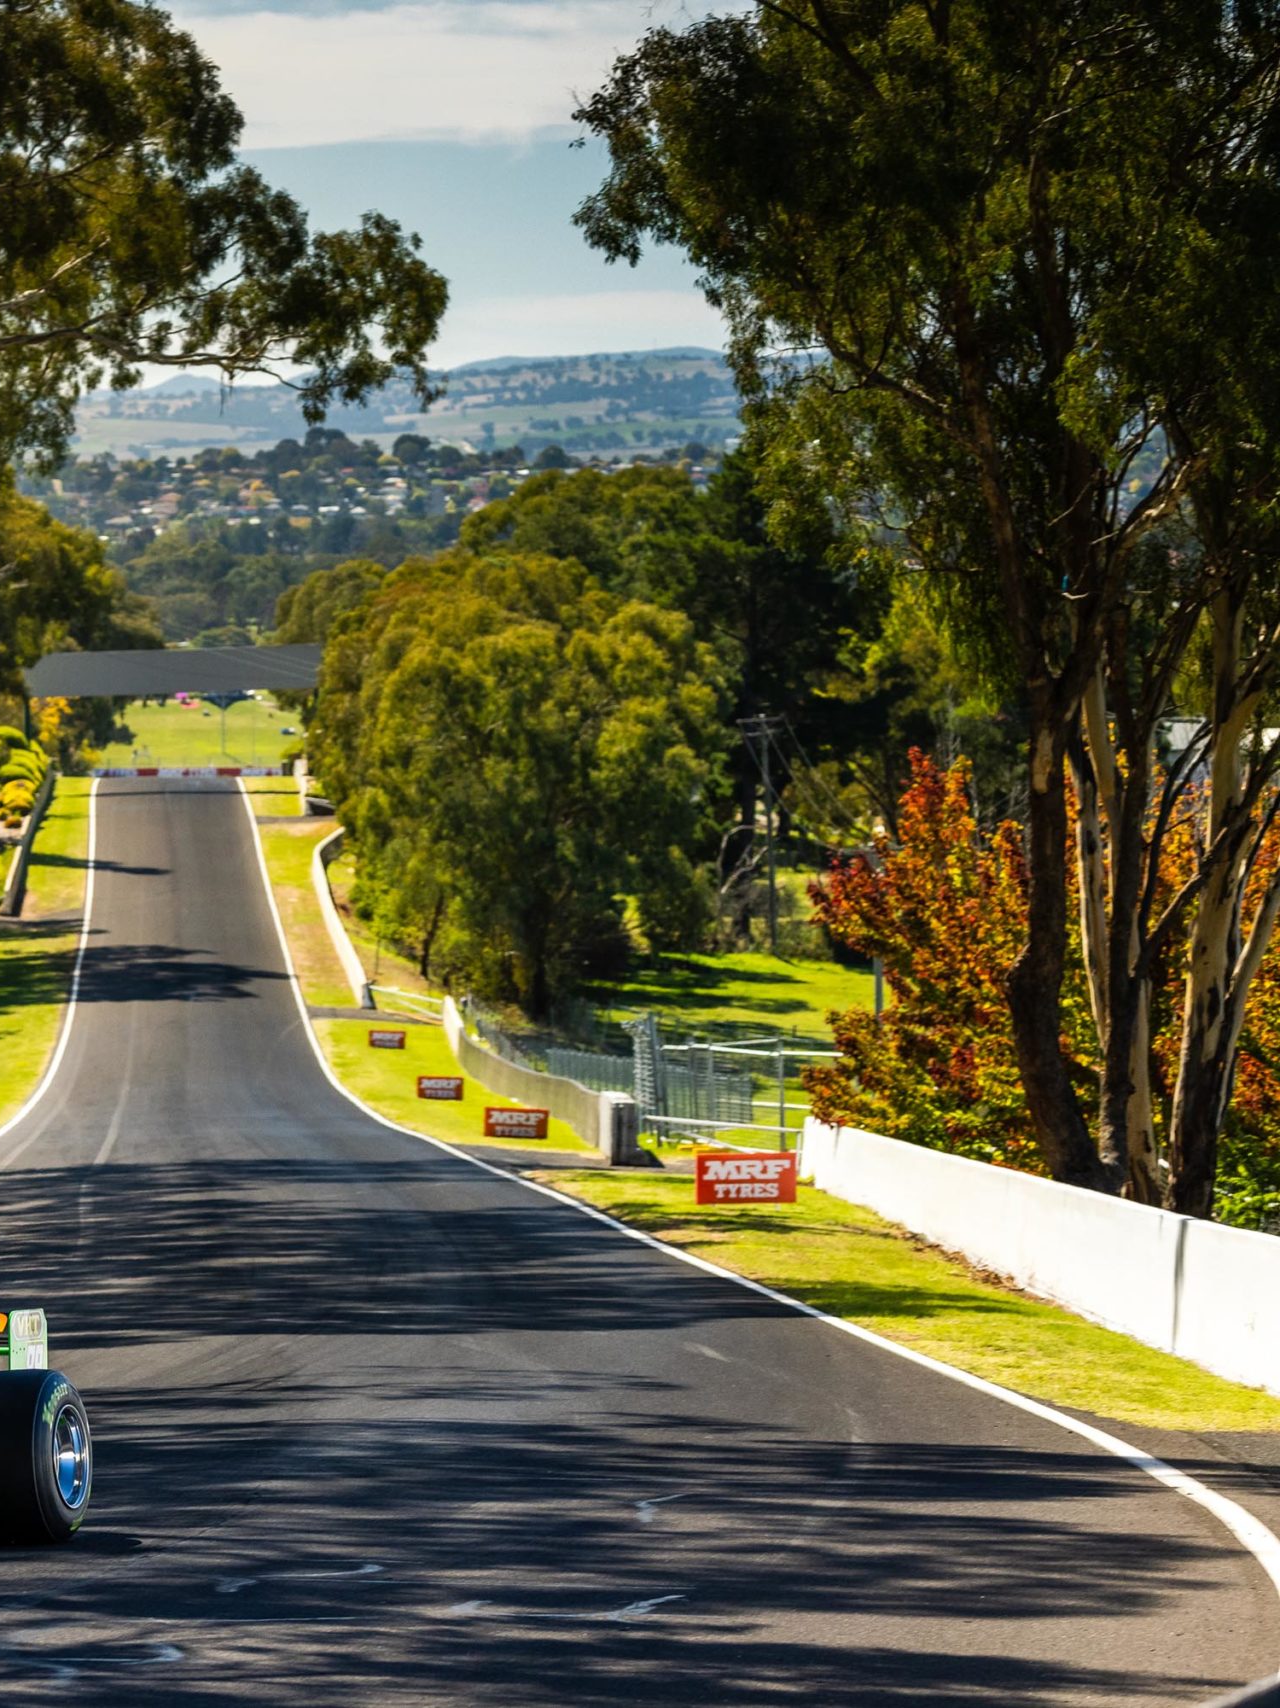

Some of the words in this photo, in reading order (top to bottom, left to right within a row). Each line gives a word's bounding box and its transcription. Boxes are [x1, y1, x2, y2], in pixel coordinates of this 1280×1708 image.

[372, 1032, 404, 1040] MRF
[420, 1078, 462, 1088] MRF
[424, 1089, 457, 1098] TYRES
[488, 1111, 545, 1125] MRF
[494, 1126, 536, 1138] TYRES
[703, 1159, 791, 1181] MRF
[714, 1183, 780, 1199] TYRES
